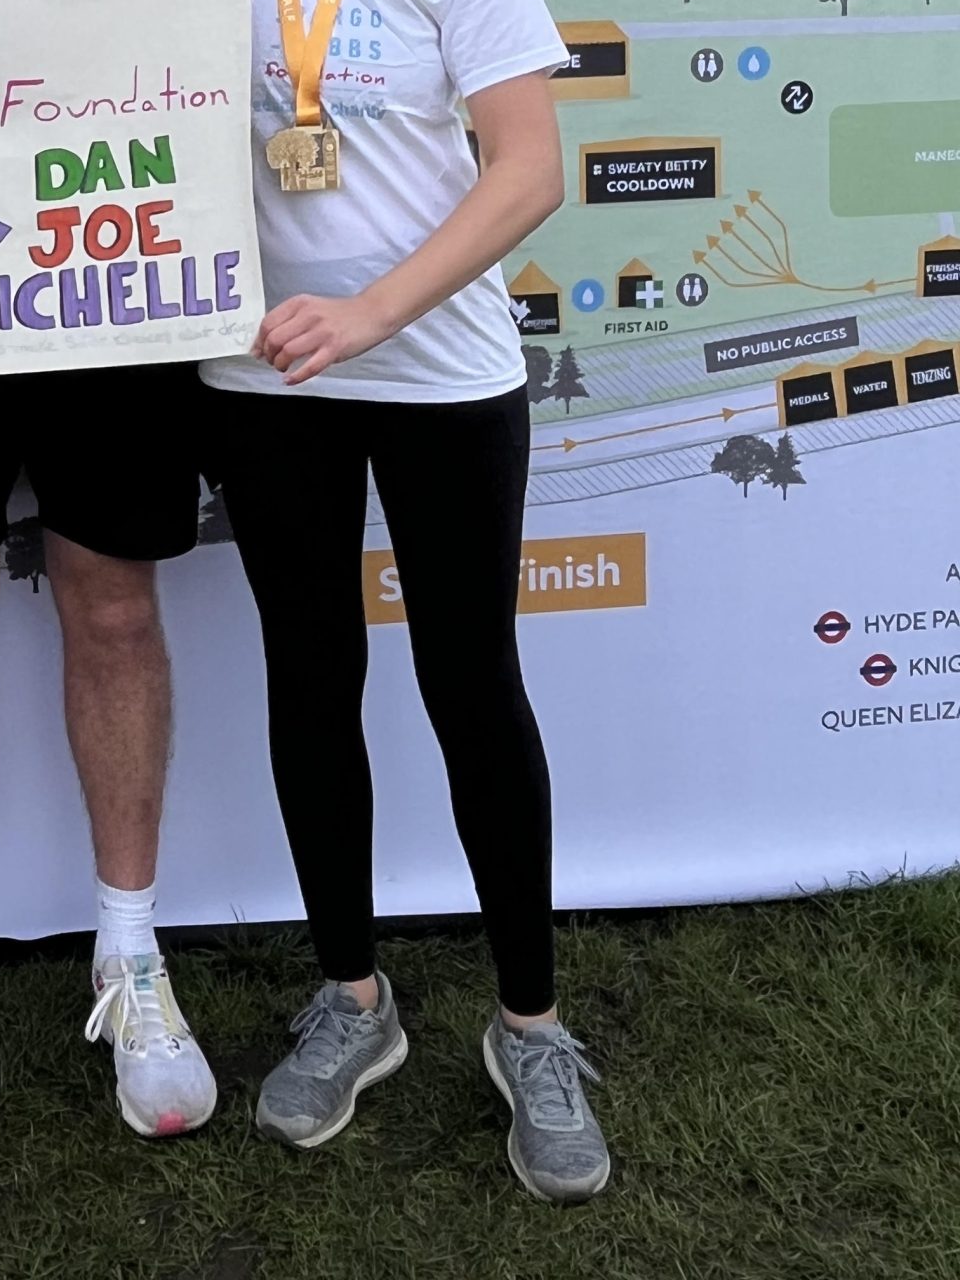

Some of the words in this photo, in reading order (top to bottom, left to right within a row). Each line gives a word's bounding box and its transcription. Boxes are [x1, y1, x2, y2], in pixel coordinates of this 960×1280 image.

[0, 66, 230, 127] Foundation
[36, 135, 176, 201] DAN
[608, 161, 662, 174] SWEATY
[665, 160, 707, 172] BETTY
[607, 177, 694, 192] COOLDOWN
[28, 200, 182, 267] JOE
[604, 322, 642, 335] FIRST
[644, 320, 669, 334] AID
[717, 348, 739, 362] NO
[741, 338, 792, 358] PUBLIC
[794, 327, 848, 348] ACCESS
[911, 366, 951, 385] TENZING
[853, 381, 888, 395] WATER
[789, 392, 830, 407] MEDALS
[864, 611, 927, 634] HYDE
[821, 705, 903, 732] QUEEN
